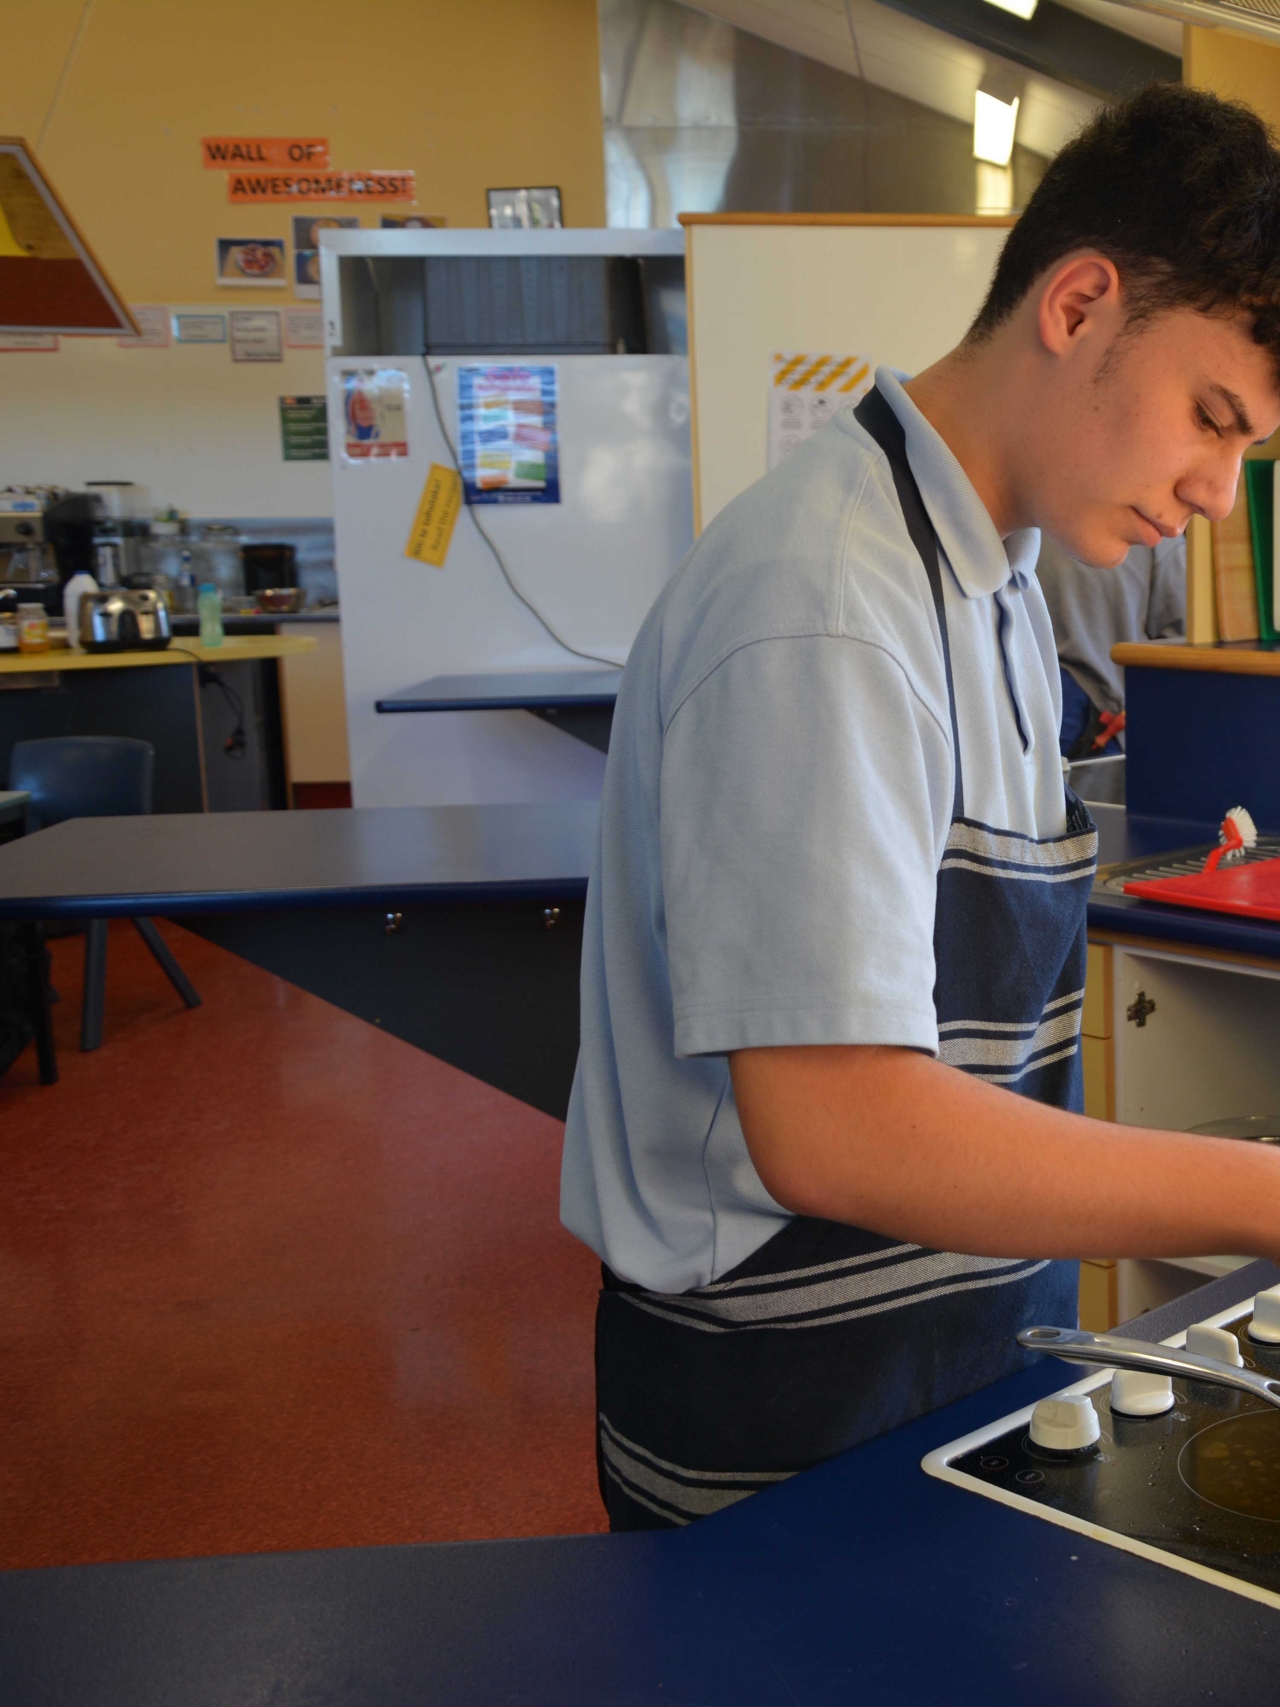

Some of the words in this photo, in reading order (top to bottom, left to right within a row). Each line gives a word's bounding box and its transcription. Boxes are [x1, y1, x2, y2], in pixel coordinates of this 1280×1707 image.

[206, 144, 267, 161] WALL
[288, 144, 317, 161] OF
[232, 177, 407, 195] AWESOMENESS!
